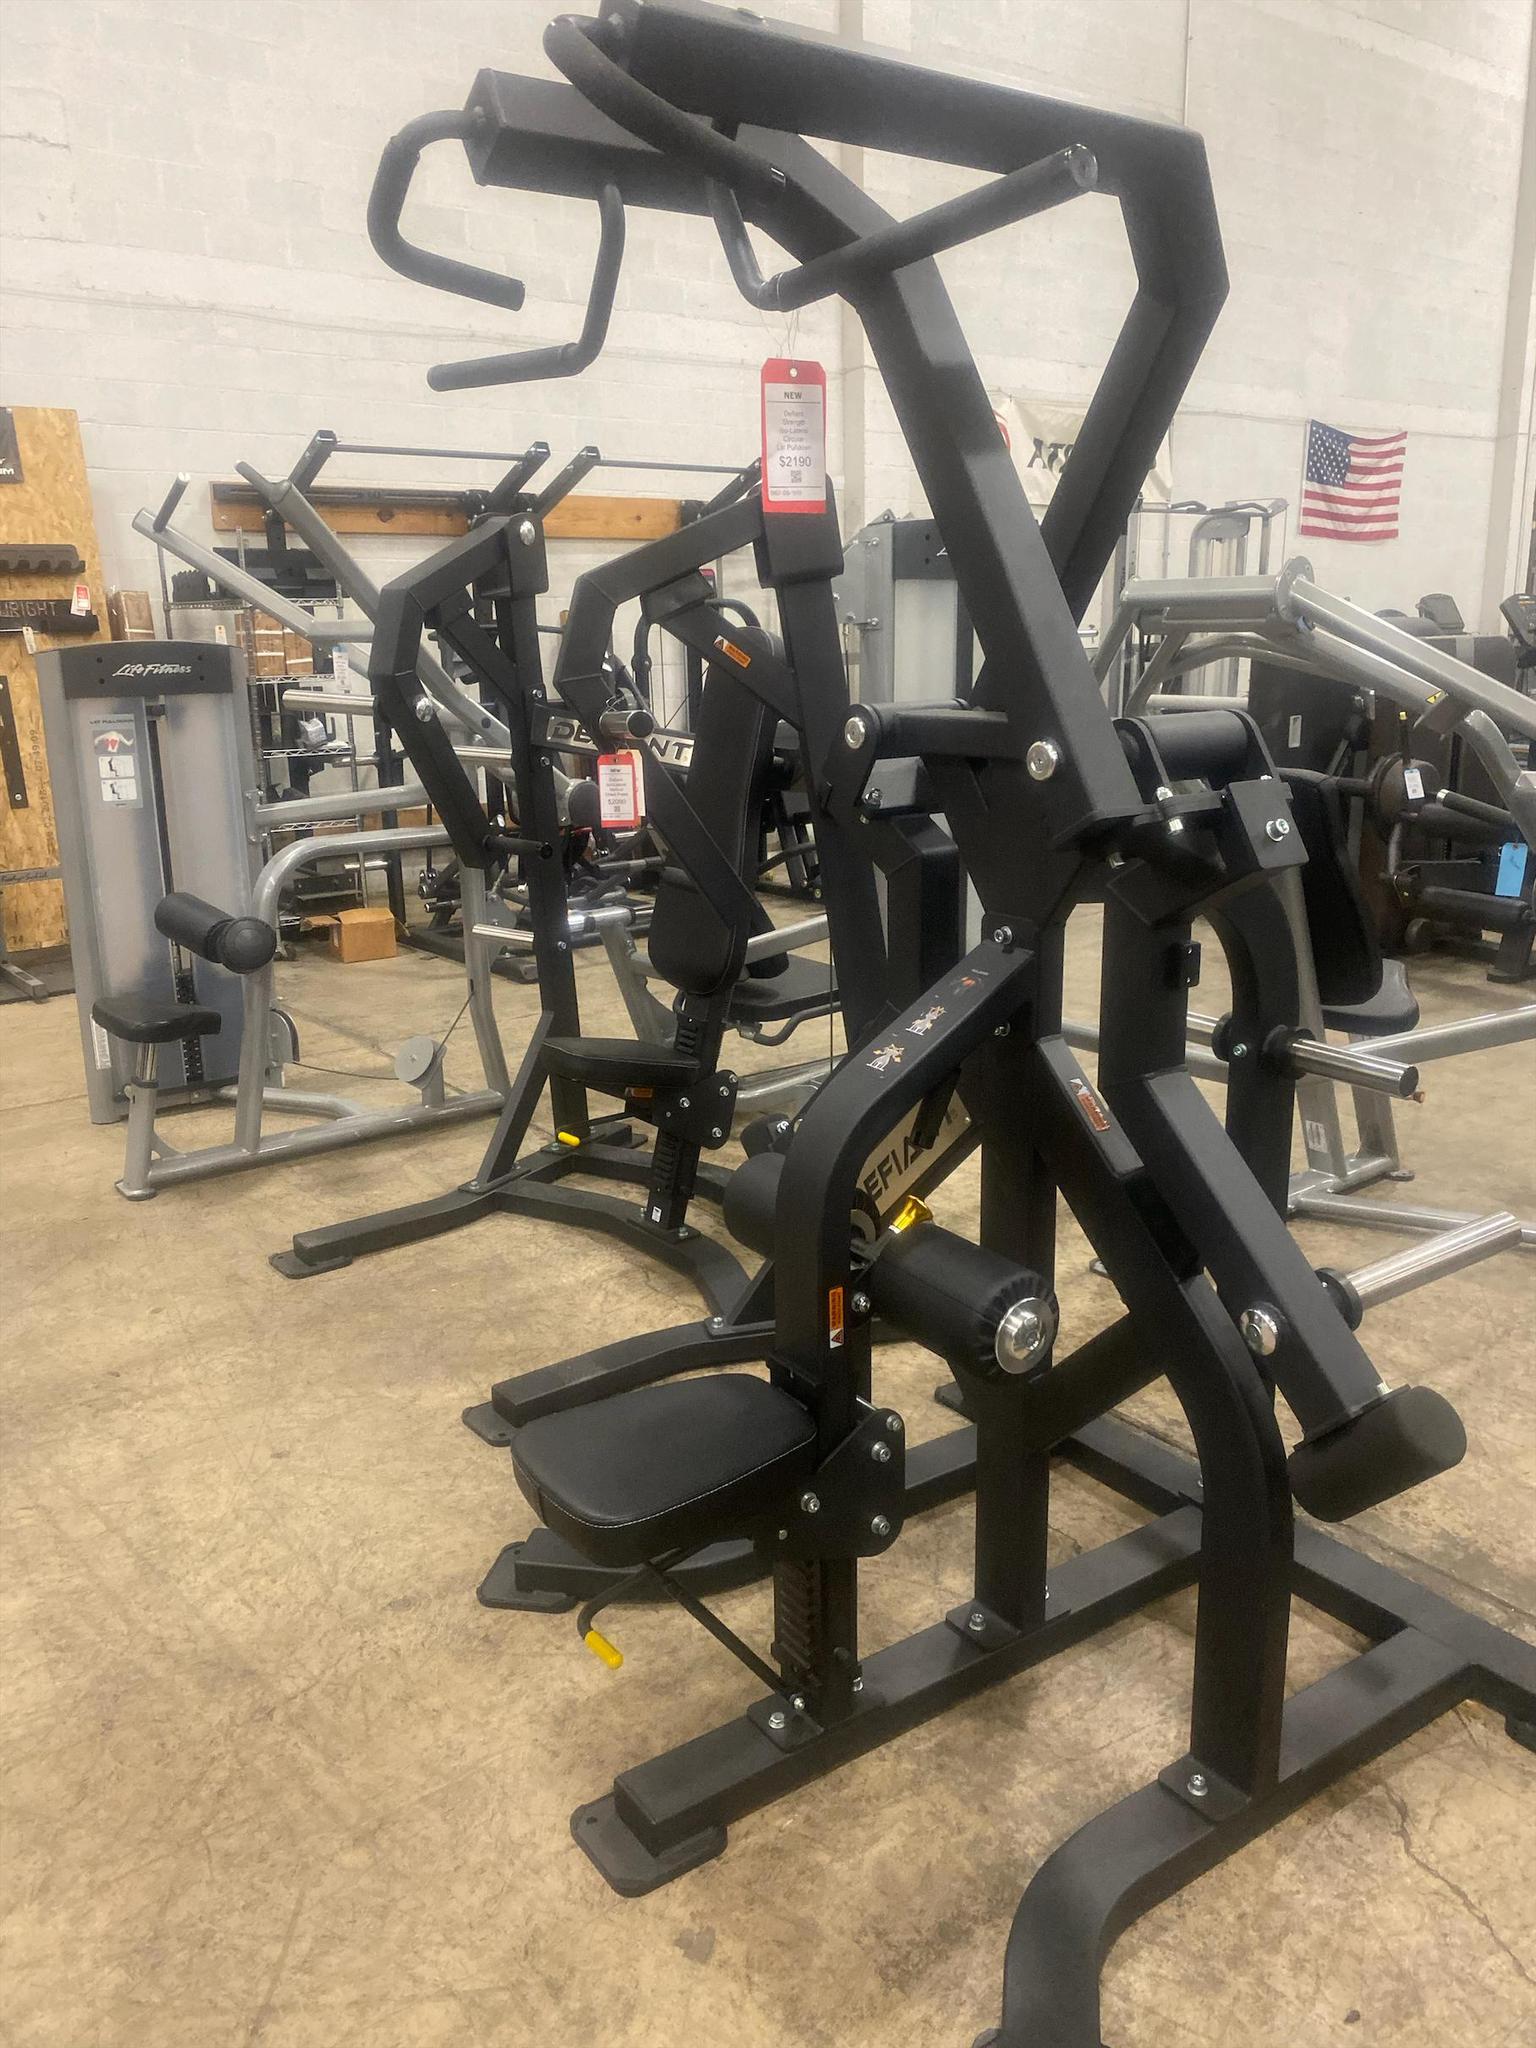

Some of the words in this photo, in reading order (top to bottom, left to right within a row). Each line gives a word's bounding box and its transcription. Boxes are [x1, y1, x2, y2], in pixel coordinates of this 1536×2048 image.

[783, 391, 802, 400] NEW
[778, 455, 812, 468] $2190
[112, 663, 145, 677] Life
[142, 663, 192, 677] Fitness
